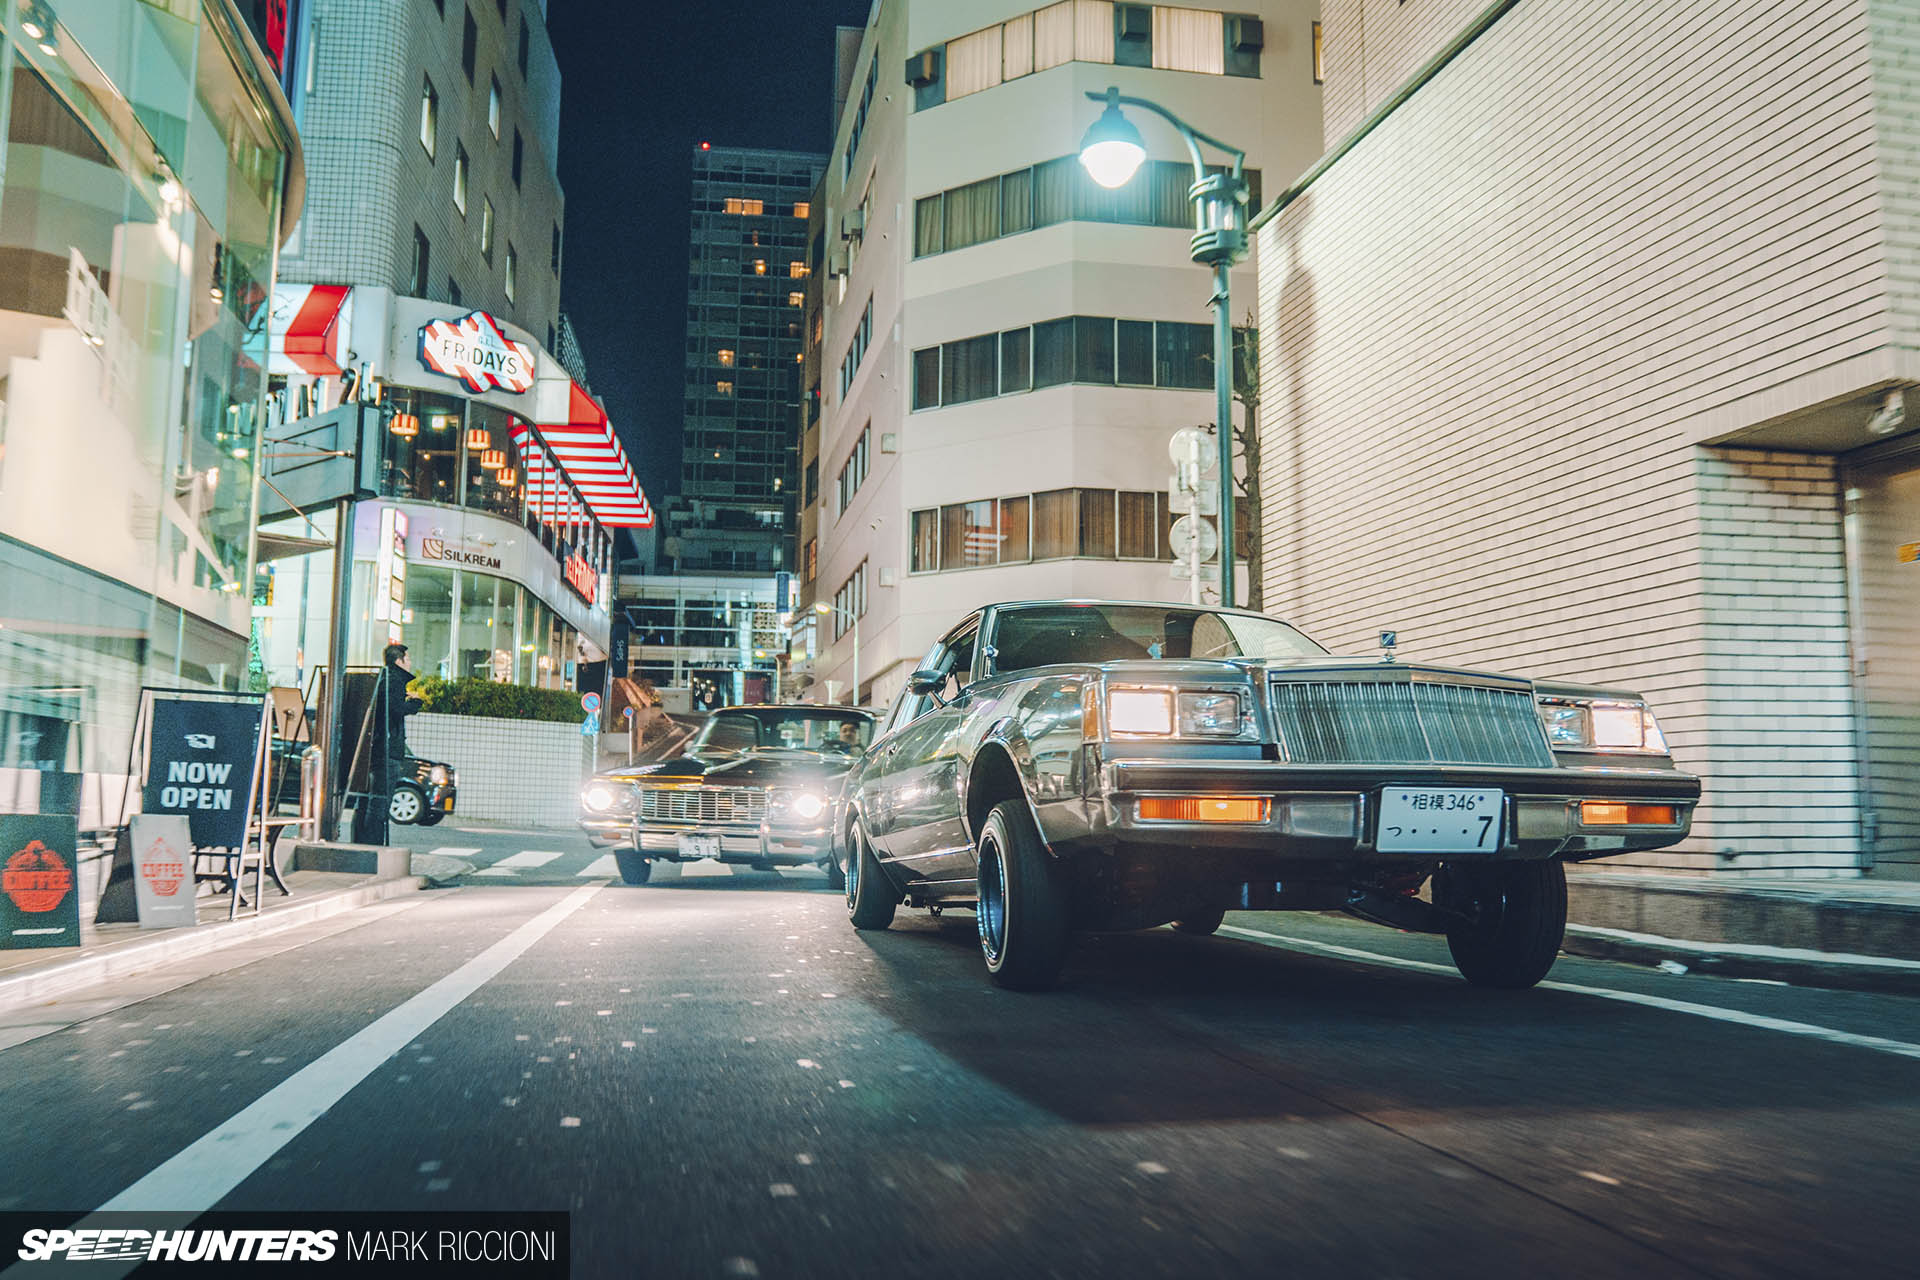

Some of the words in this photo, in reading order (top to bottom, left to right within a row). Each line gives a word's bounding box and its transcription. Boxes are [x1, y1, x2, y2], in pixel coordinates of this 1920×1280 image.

[443, 339, 518, 375] FRIDAYS
[443, 548, 502, 570] SILKREAM
[167, 761, 233, 785] NOW
[160, 786, 233, 810] OPEN
